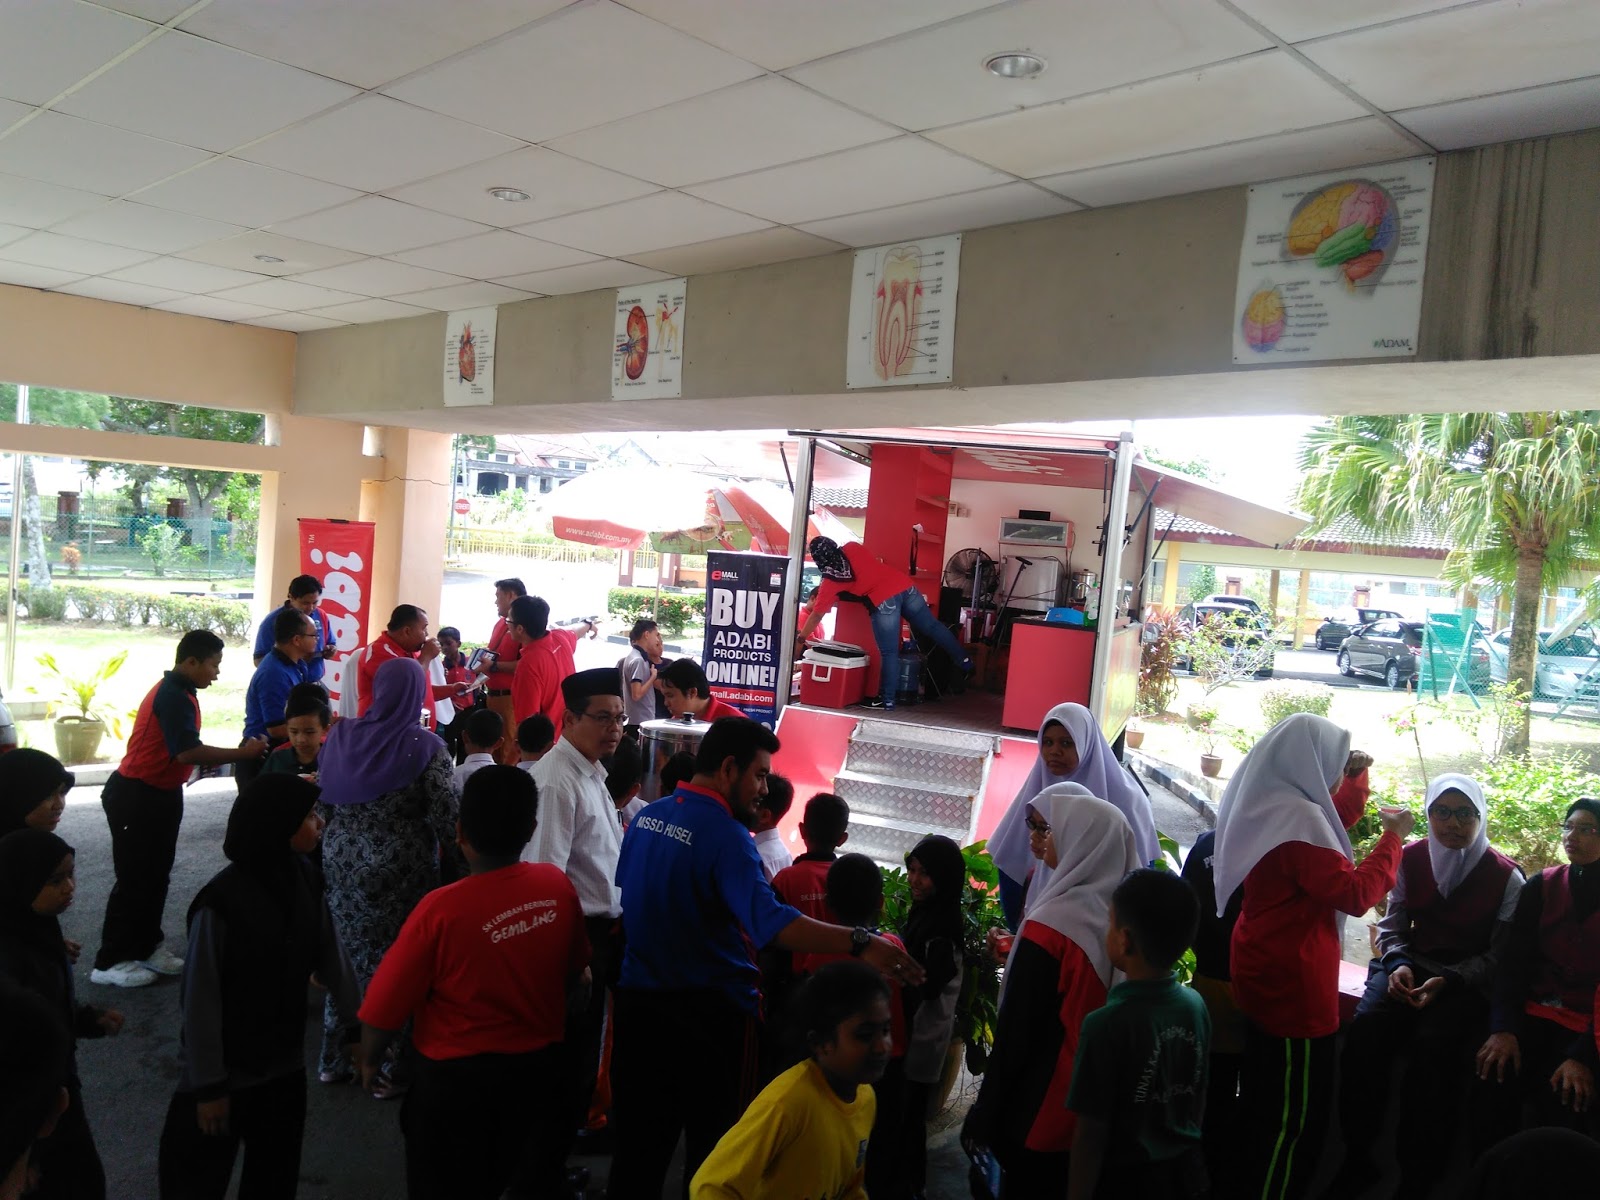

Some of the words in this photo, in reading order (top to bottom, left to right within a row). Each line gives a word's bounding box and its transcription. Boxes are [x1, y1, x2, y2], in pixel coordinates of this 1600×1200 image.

[308, 534, 315, 544] TM
[565, 526, 632, 544] www.adabi.com.my
[710, 587, 781, 631] BUY
[713, 630, 772, 651] ADABI
[713, 648, 772, 663] PRODUCTS
[705, 660, 777, 688] ONLINE!
[636, 816, 664, 833] MSSD
[663, 823, 693, 846] HUSEL
[482, 921, 494, 933] SK
[491, 905, 523, 925] LEMBAH
[523, 899, 557, 911] BERINGIN
[490, 909, 557, 944] GEMILANG
